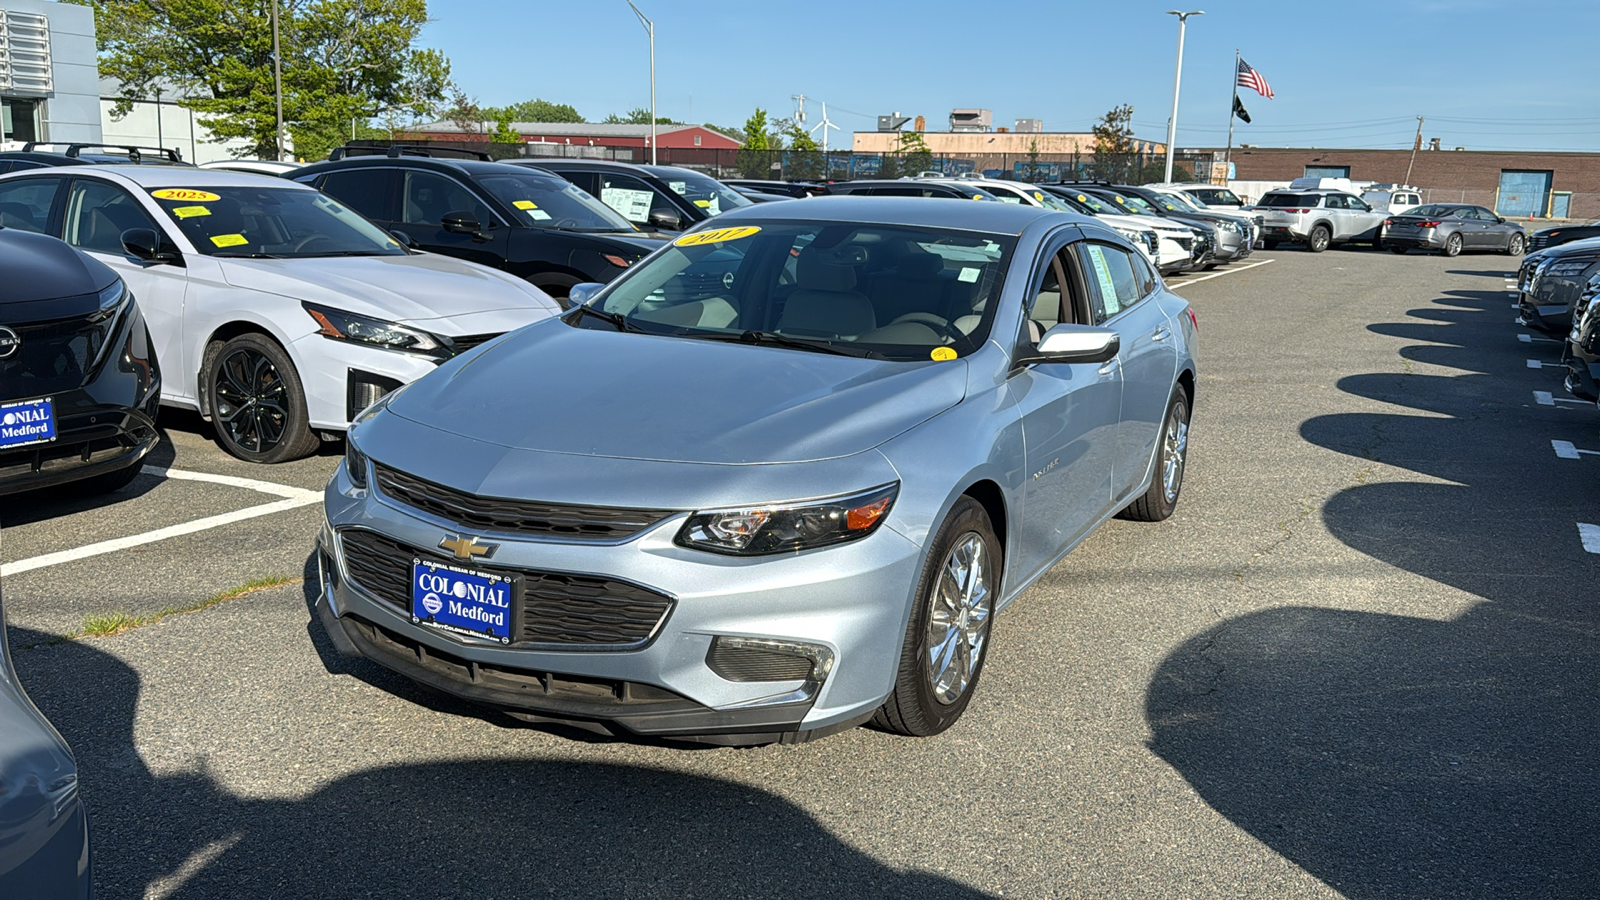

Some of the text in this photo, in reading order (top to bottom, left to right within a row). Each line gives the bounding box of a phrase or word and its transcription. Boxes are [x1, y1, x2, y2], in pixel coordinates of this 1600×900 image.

[164, 190, 208, 199] 2025
[684, 227, 749, 245] 2017
[2, 423, 48, 438] Medford
[422, 560, 449, 570] COLONIAL
[449, 565, 469, 574] NISSAN
[476, 571, 502, 581] MEDFORD
[419, 573, 509, 608] COLONIAL
[448, 600, 504, 626] Medford
